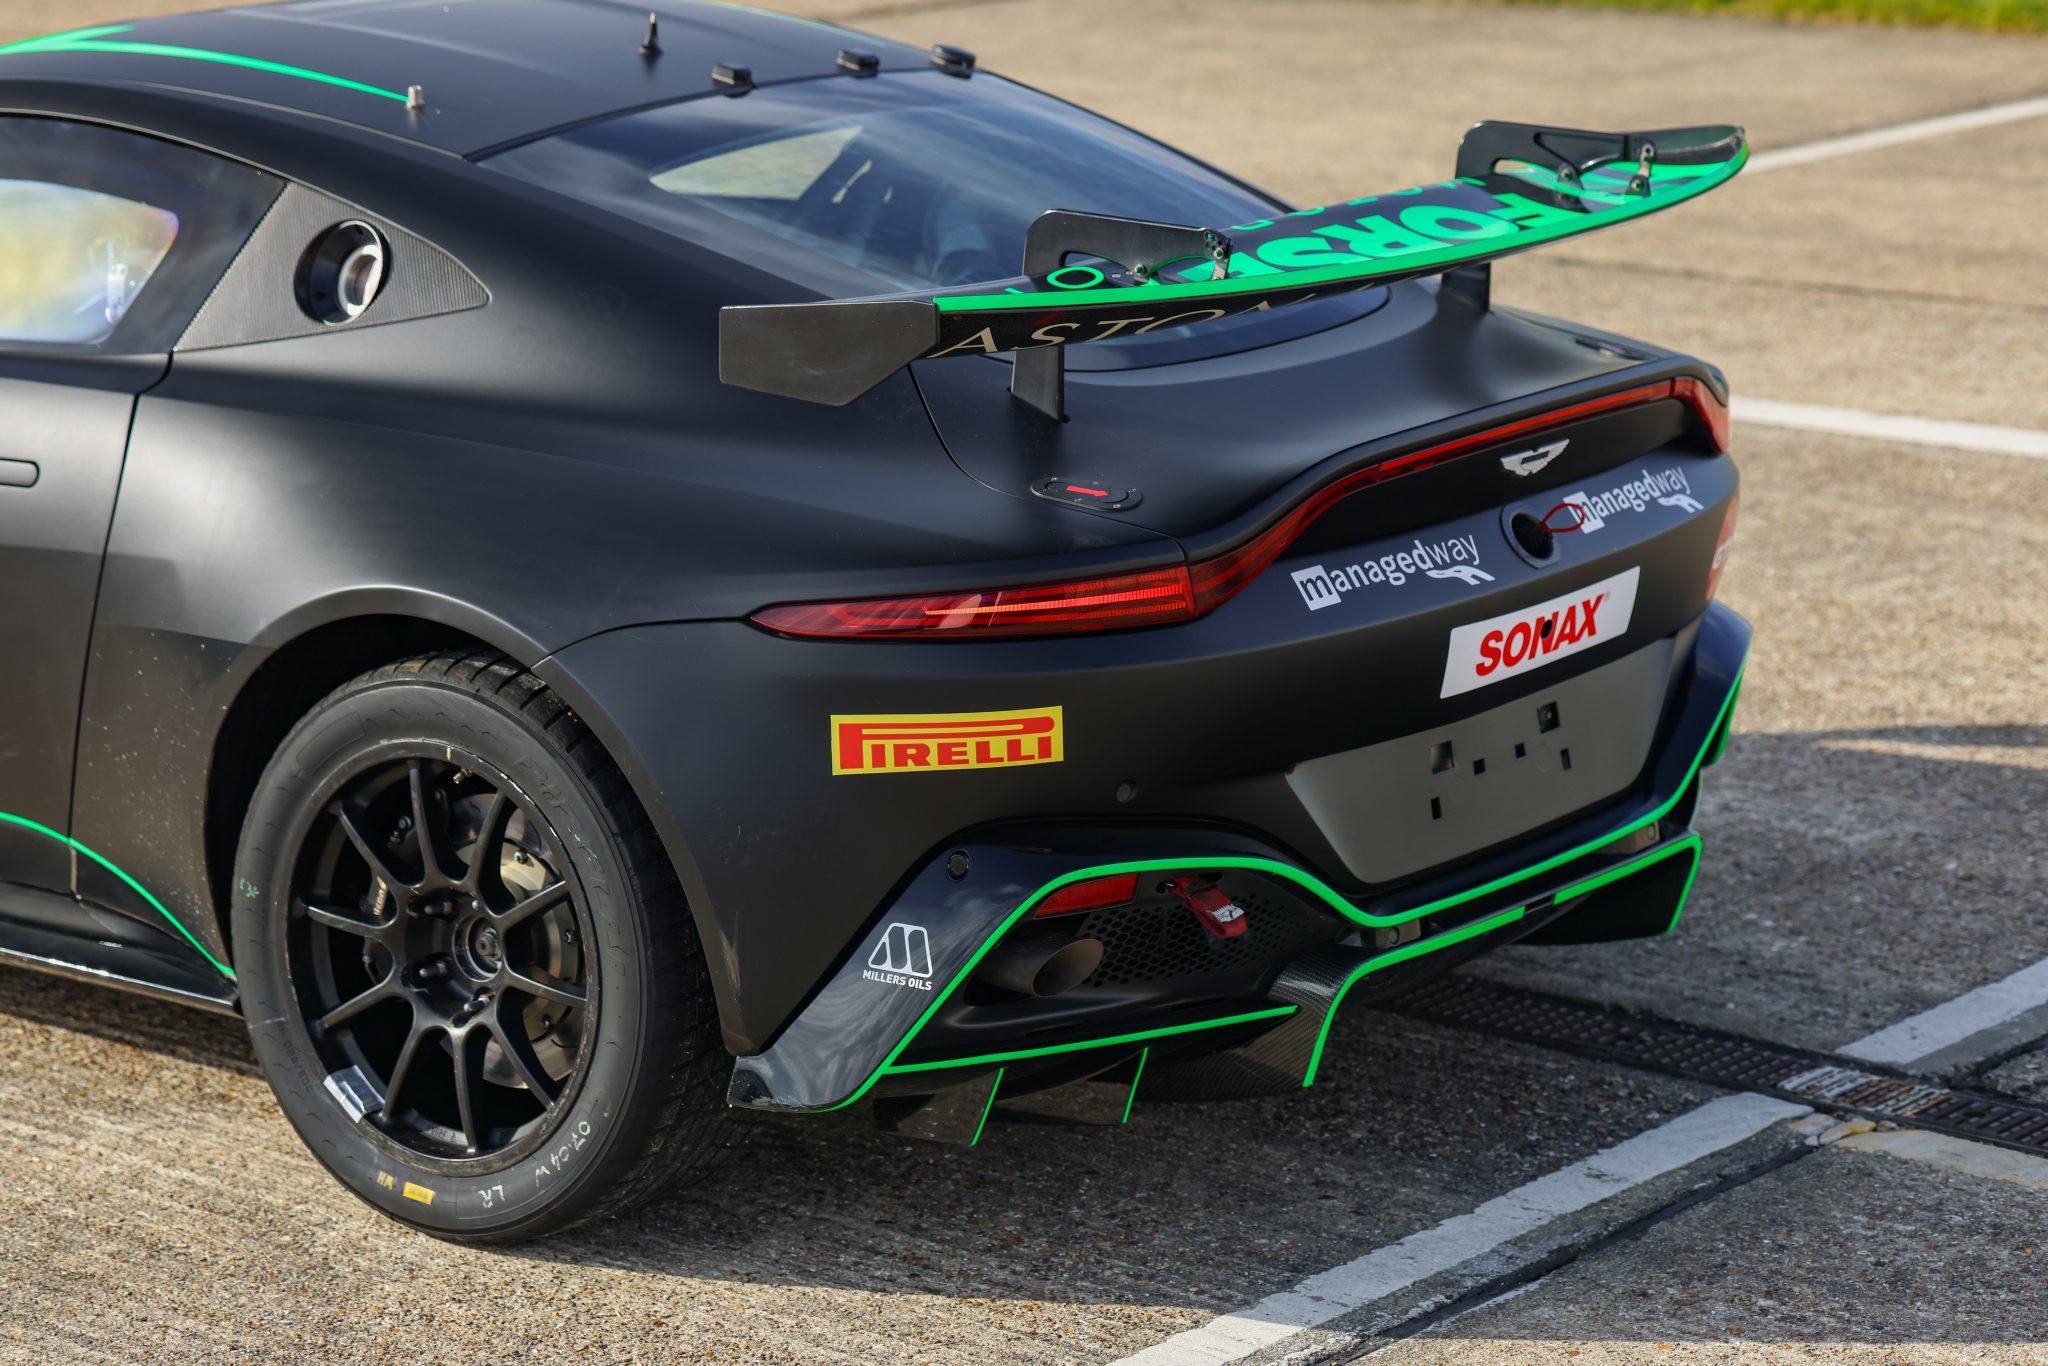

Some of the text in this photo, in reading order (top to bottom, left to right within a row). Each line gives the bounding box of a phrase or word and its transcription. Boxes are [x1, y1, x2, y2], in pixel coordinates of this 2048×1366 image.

[1568, 467, 1691, 525] managedway
[1298, 534, 1480, 604] managedway
[1475, 592, 1605, 677] SONAX
[838, 715, 1055, 770] PIRELLI
[862, 969, 932, 991] MILLERS OILS
